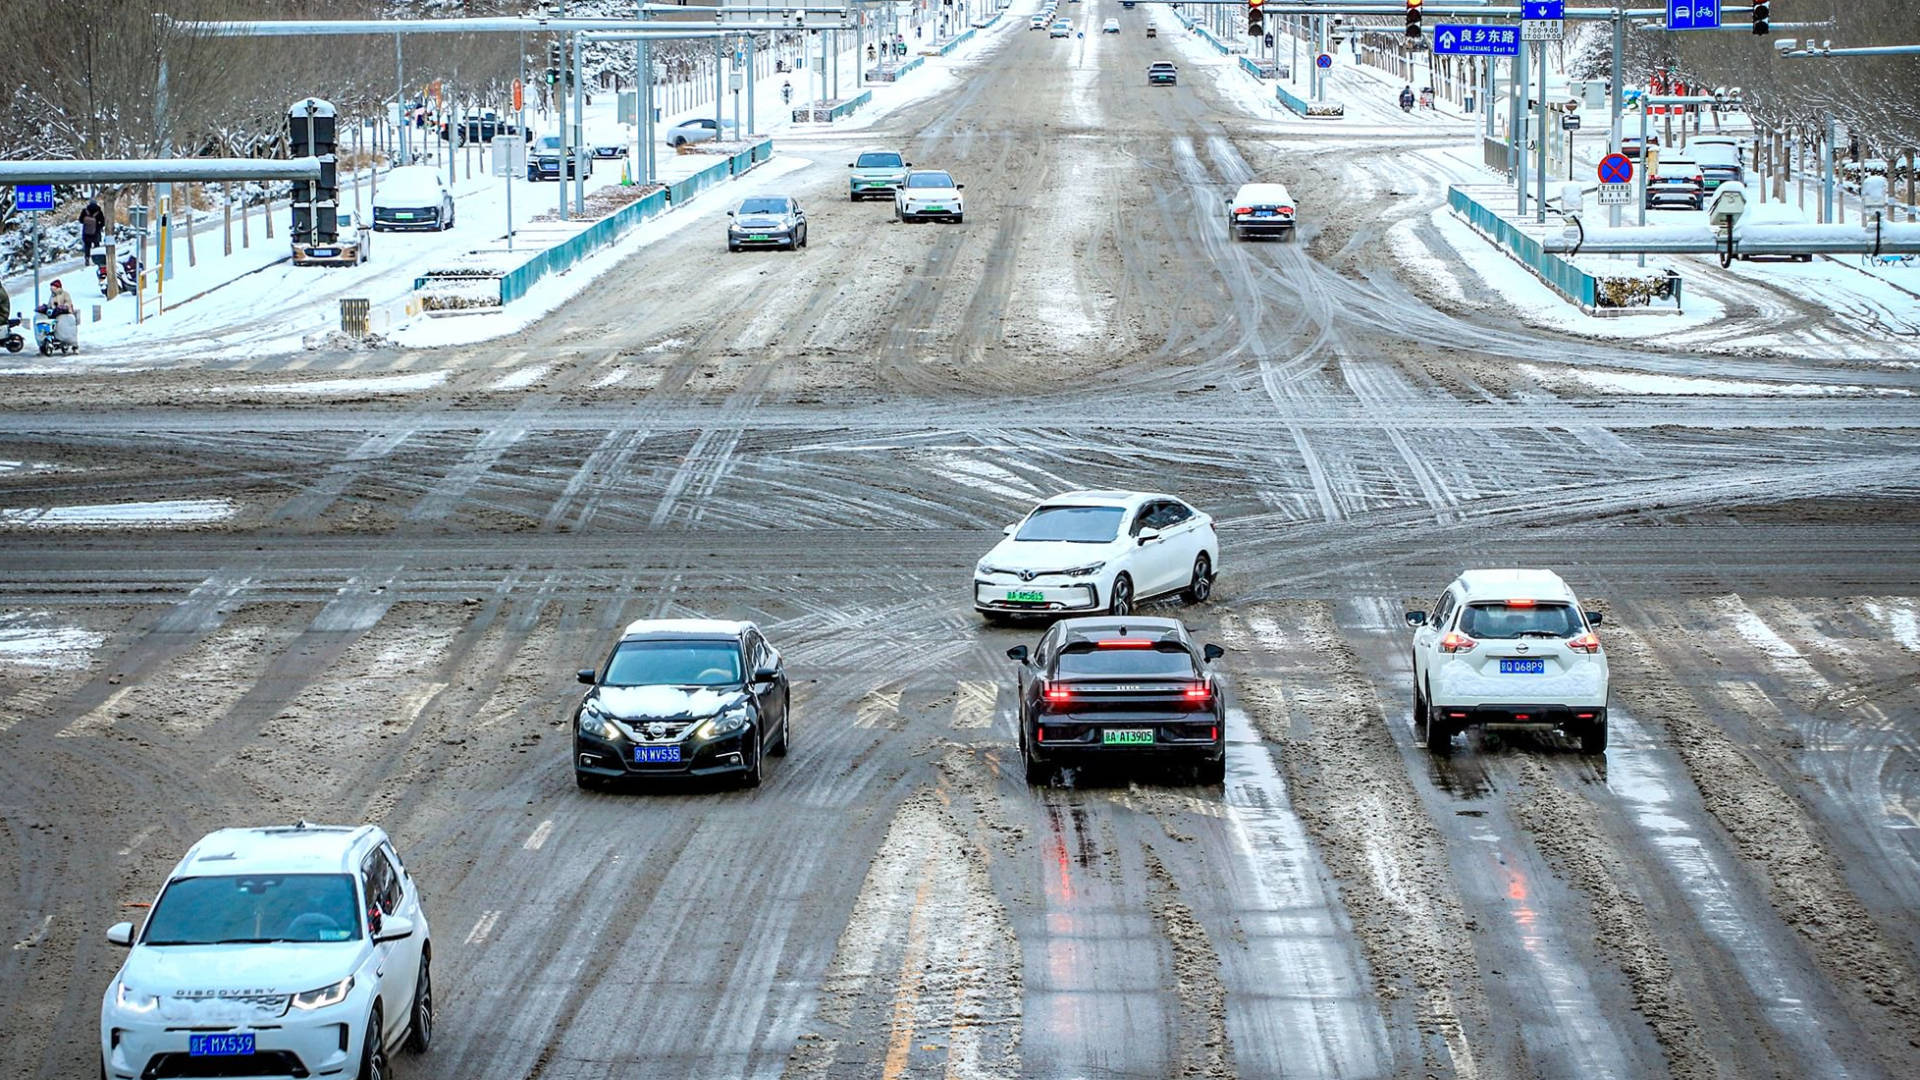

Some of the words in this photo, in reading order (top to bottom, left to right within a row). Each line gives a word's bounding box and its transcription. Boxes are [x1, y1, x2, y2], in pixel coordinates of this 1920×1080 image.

[1461, 29, 1515, 44] 良乡东路
[18, 191, 50, 203] 禁止逆行
[176, 987, 276, 996] DISCOVERY
